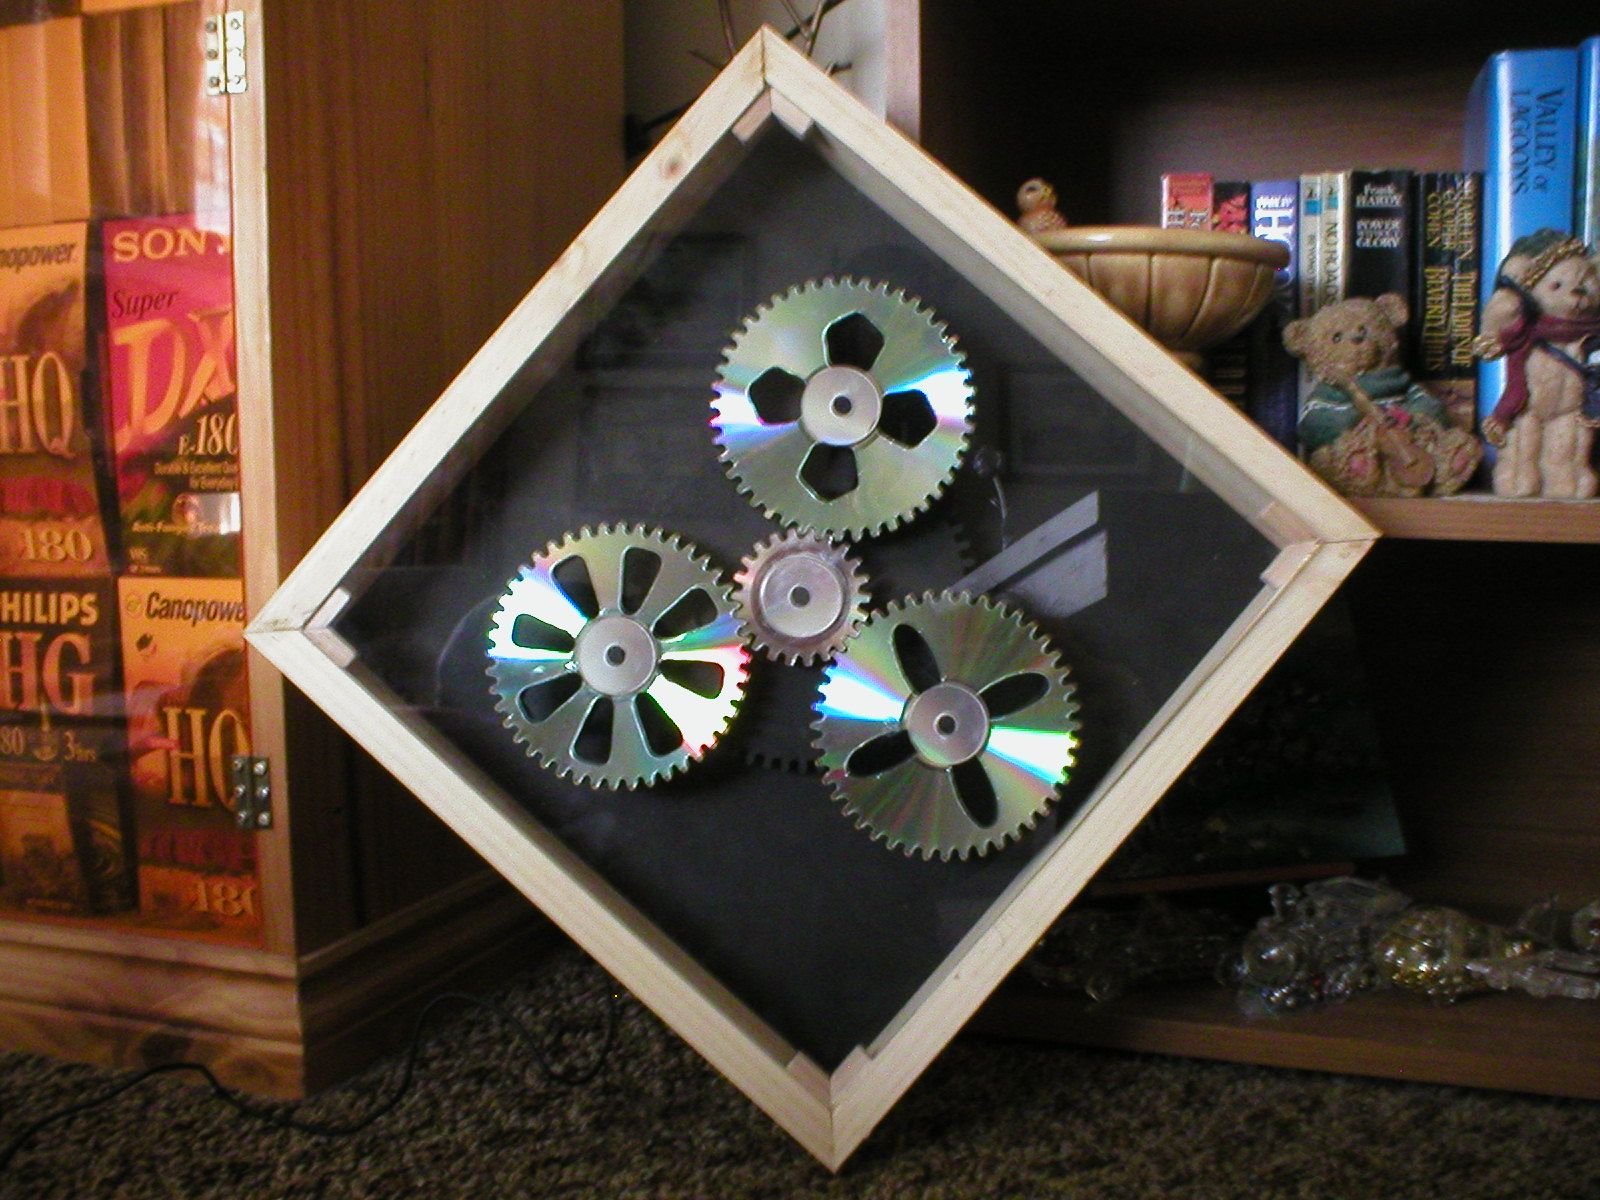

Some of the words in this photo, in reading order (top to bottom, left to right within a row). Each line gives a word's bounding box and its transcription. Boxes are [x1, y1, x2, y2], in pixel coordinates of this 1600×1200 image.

[112, 290, 179, 320] Super
[0, 350, 75, 459] HQ
[22, 526, 93, 562] 180
[0, 631, 96, 716] HG
